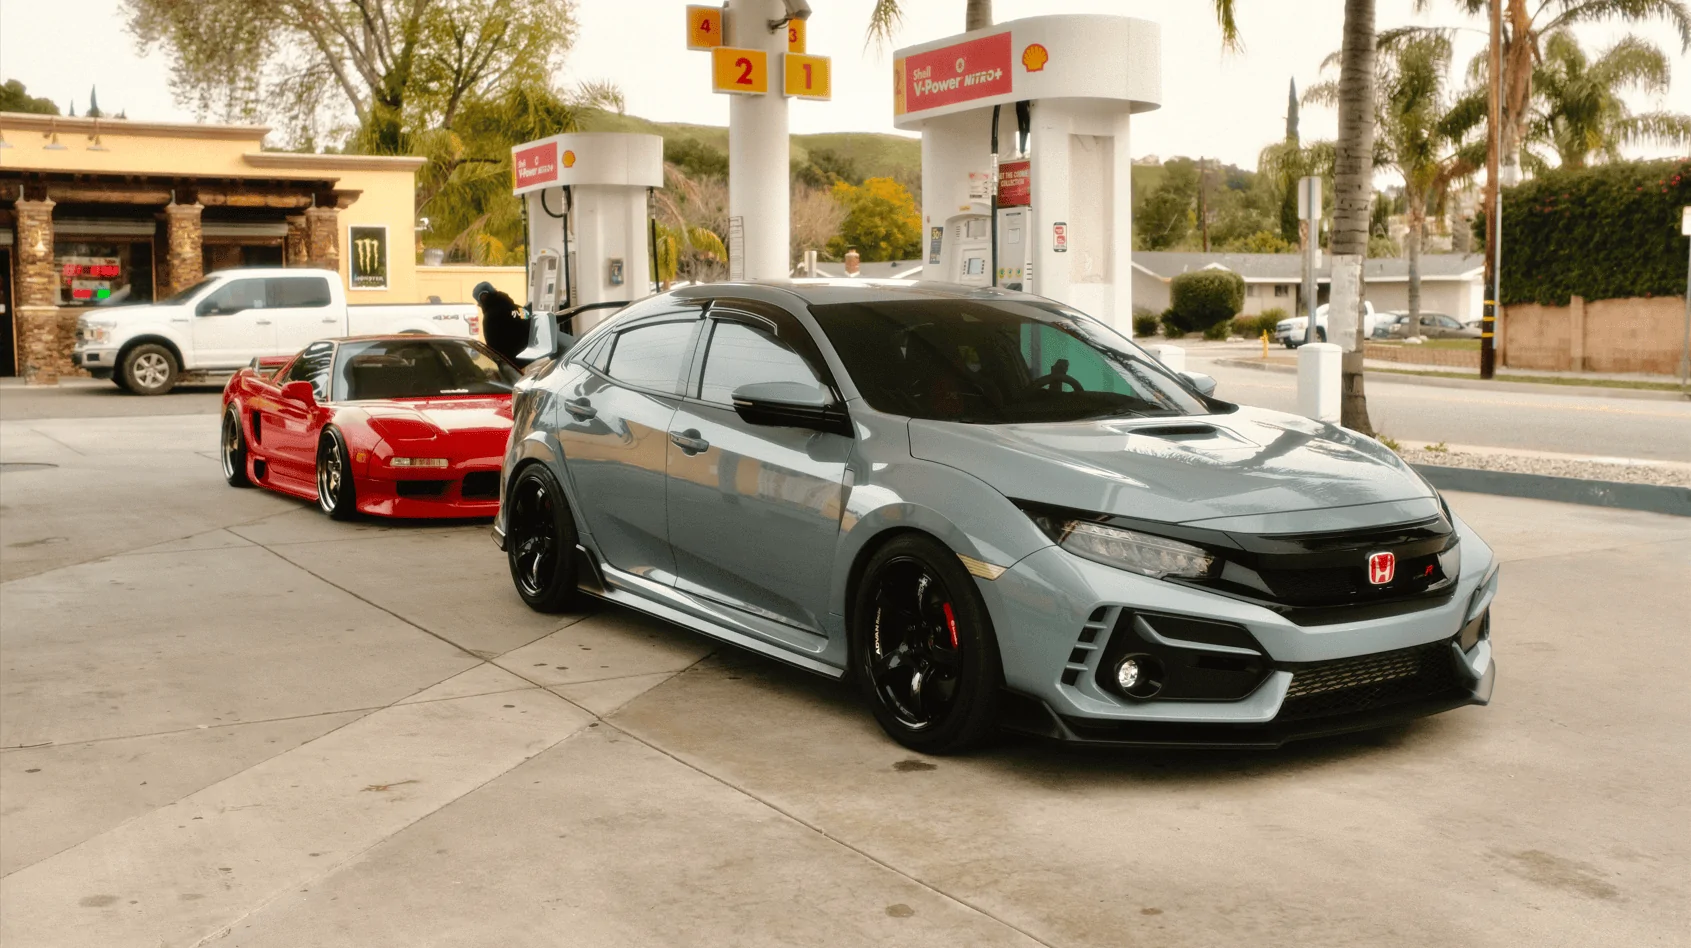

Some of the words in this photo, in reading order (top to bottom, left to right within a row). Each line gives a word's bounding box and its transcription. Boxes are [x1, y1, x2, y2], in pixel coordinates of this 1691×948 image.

[700, 19, 711, 33] 4
[788, 28, 798, 43] 3
[735, 57, 753, 85] 2
[803, 63, 812, 90] 1
[913, 66, 931, 81] Shell
[913, 77, 960, 97] V-Power
[1424, 564, 1434, 576] R
